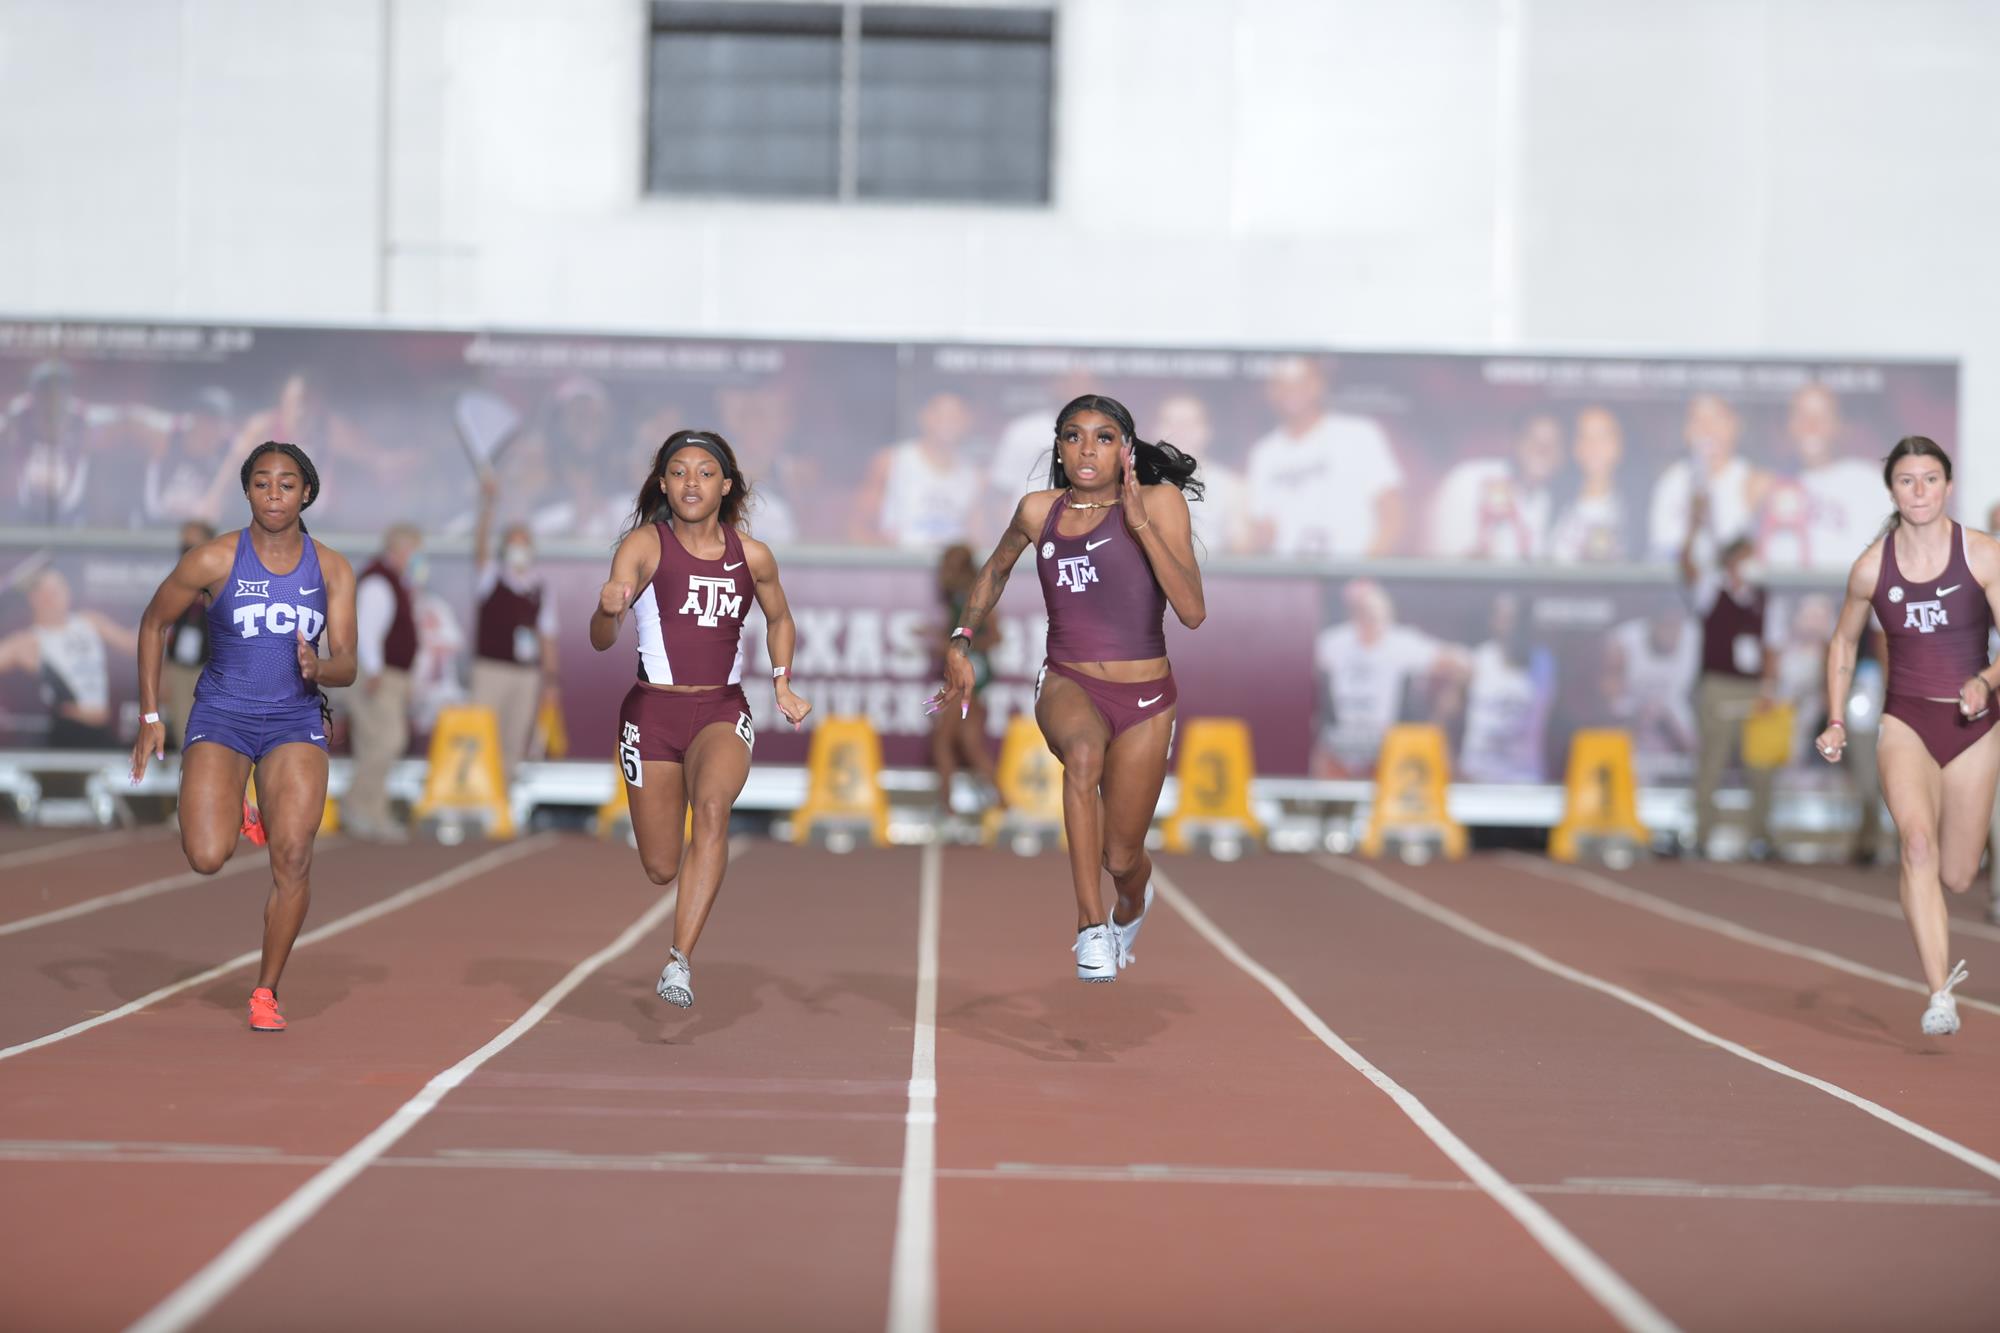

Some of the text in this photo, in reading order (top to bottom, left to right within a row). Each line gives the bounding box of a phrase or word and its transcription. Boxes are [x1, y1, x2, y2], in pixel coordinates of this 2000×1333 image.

[233, 603, 325, 641] TCU
[739, 715, 752, 745] 5
[446, 734, 480, 792] 7
[623, 746, 638, 782] 5
[1195, 750, 1229, 809] 3
[1397, 754, 1431, 815] 2
[1594, 762, 1615, 820] 1
